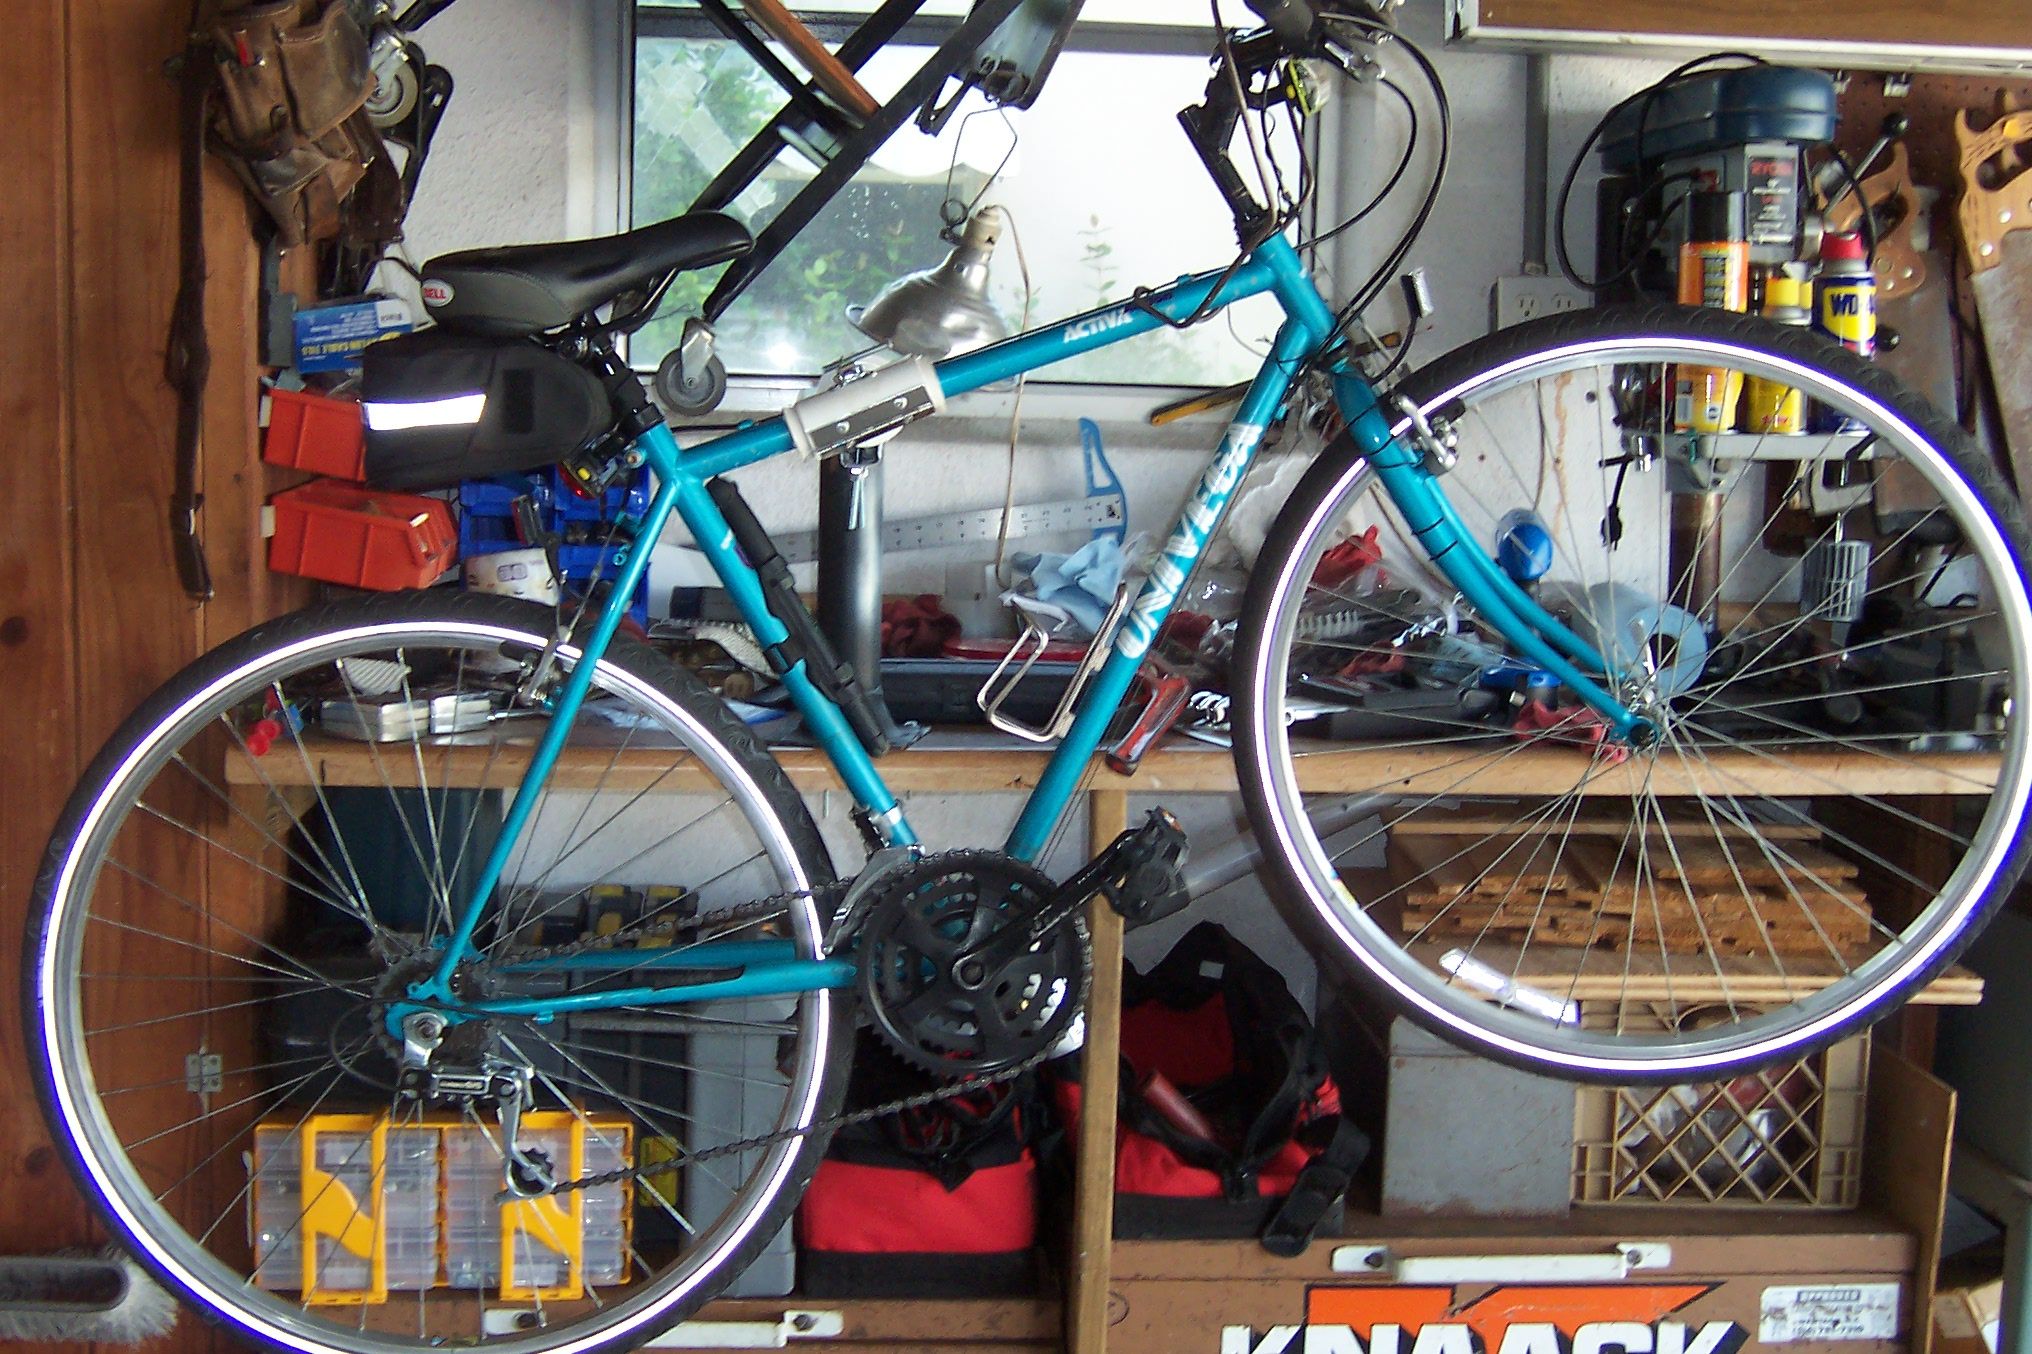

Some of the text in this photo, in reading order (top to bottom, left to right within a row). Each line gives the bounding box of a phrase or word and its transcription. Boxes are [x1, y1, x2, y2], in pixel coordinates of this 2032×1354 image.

[423, 287, 446, 299] BELL
[1062, 306, 1134, 344] ACTIVA
[1115, 424, 1263, 659] UNIVEGA
